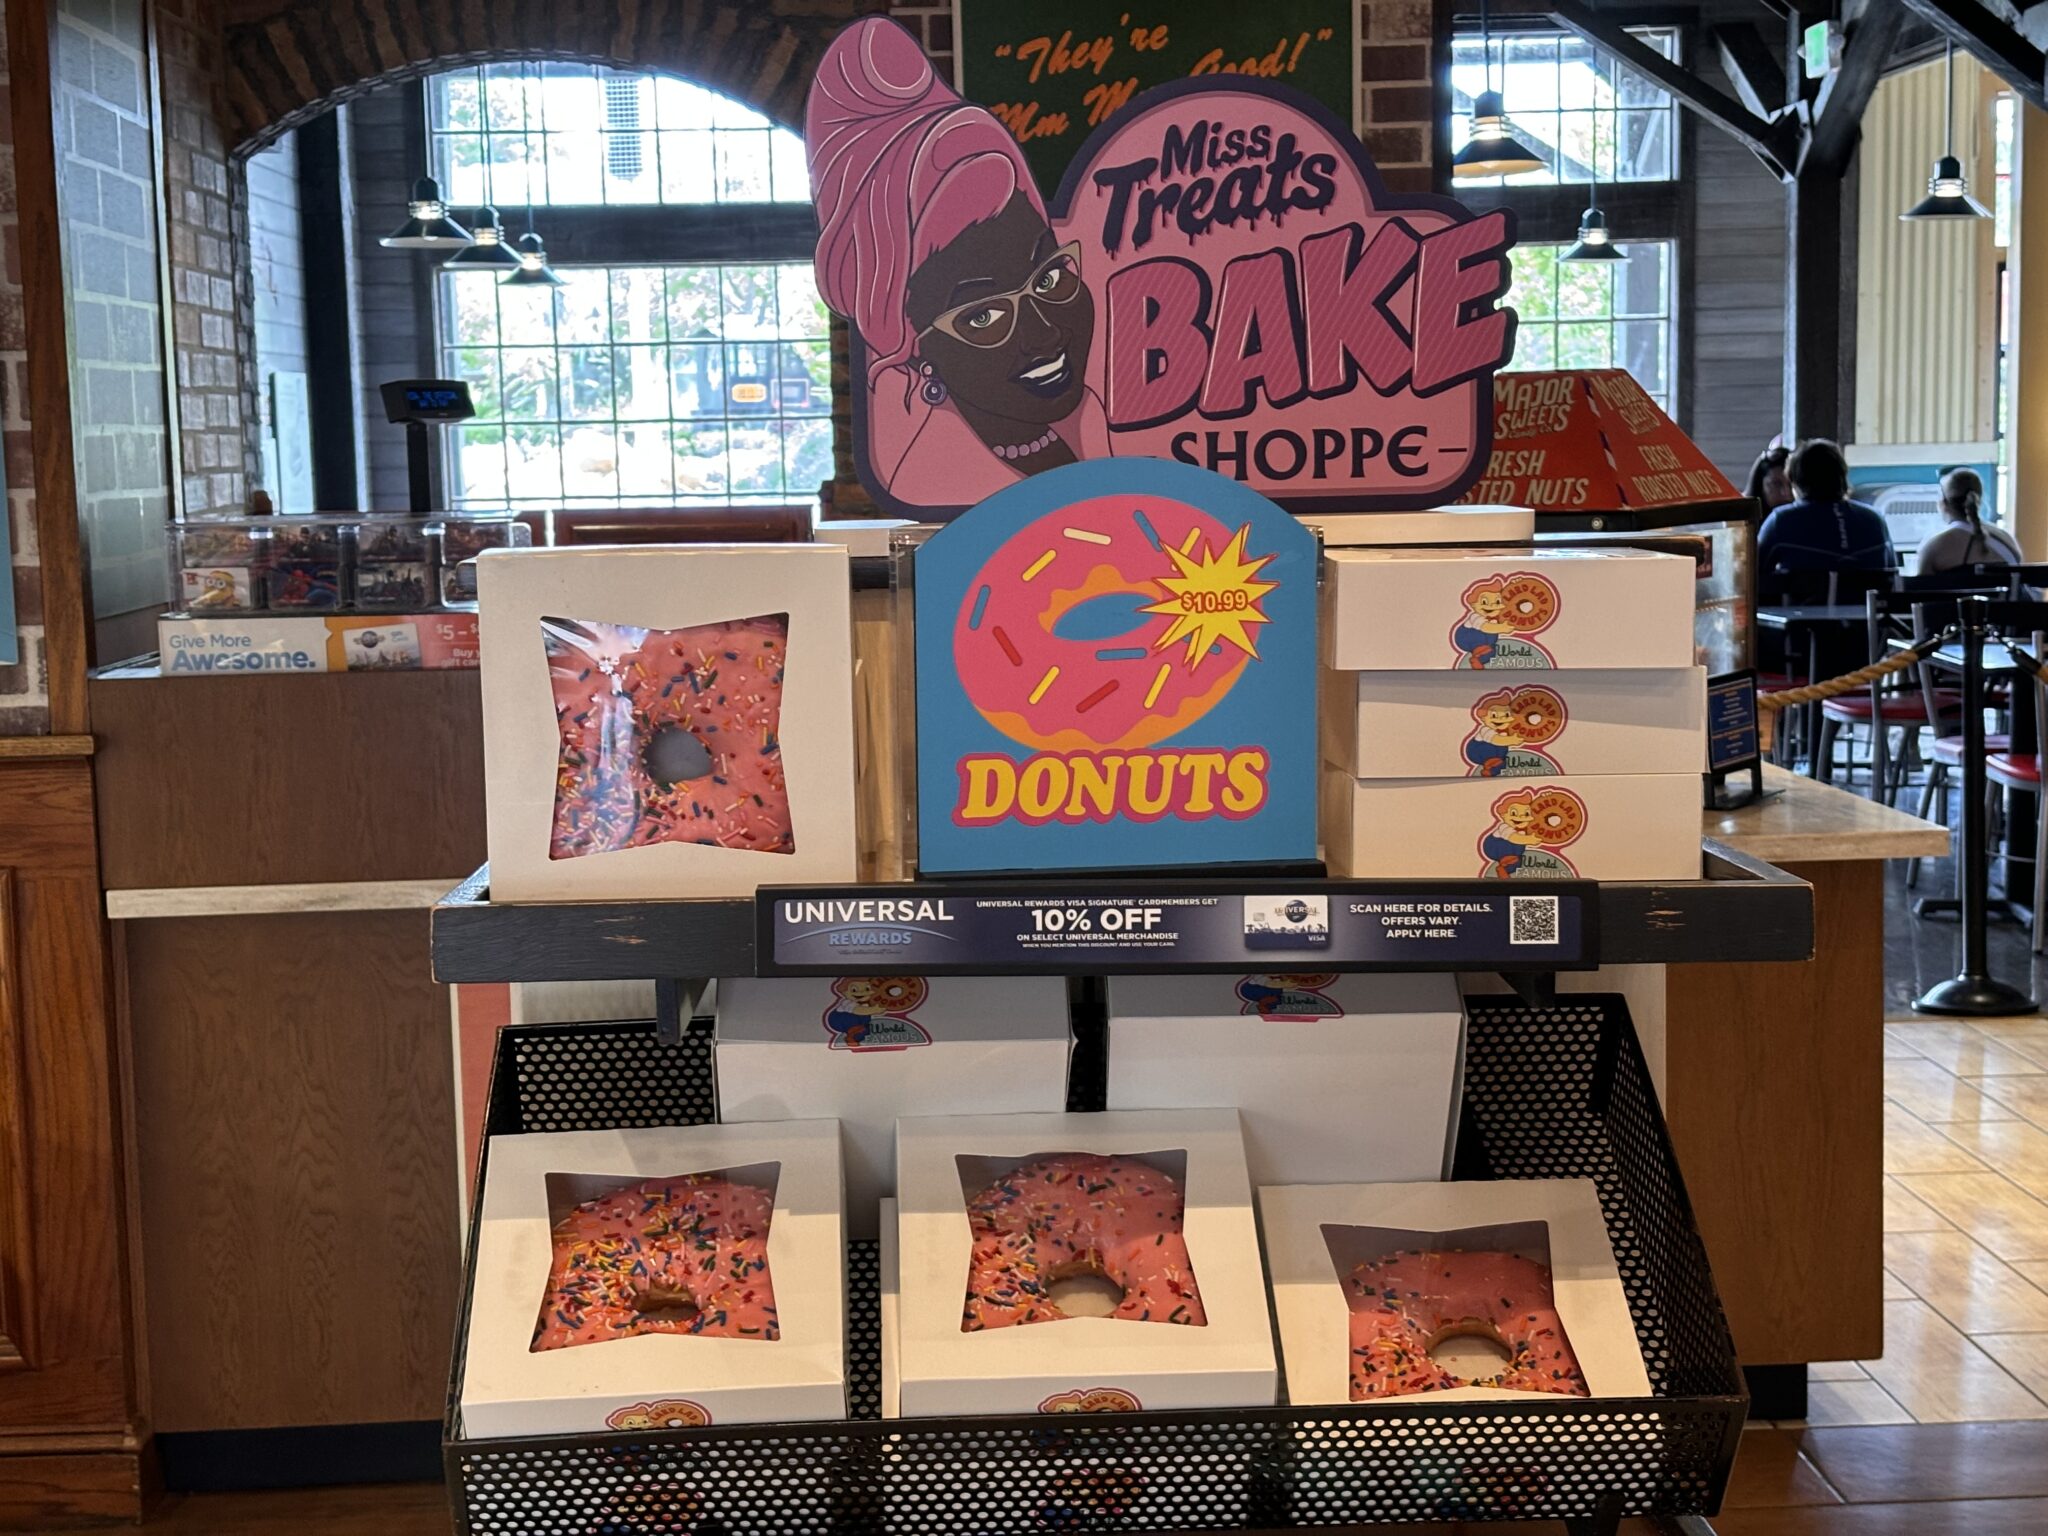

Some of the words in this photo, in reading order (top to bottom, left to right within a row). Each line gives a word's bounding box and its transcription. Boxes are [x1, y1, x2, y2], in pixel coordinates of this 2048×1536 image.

[1160, 119, 1271, 183] Miss
[1092, 133, 1337, 261] Treats
[1105, 209, 1519, 432] BAKE
[1493, 376, 1574, 411] MAJOR
[1494, 404, 1571, 439] SWEETS
[1170, 425, 1429, 481] SHOPPE
[1638, 444, 1682, 471] FRESH
[1486, 450, 1546, 477] RESH
[1524, 477, 1589, 505] NUTS
[1631, 473, 1689, 502] ROASTED
[1682, 469, 1722, 495] NUTS
[1181, 590, 1248, 613] $10.99
[1503, 609, 1549, 626] DONUTS
[169, 635, 206, 649] Give
[210, 634, 252, 648] More
[1496, 644, 1533, 657] World
[171, 650, 316, 671] Awesome.
[1489, 657, 1544, 668] FAMOUS
[1512, 719, 1555, 737] DONUTS
[1505, 756, 1542, 769] World
[955, 748, 1268, 823] DONUTS
[1531, 822, 1575, 839] DONUTS
[1521, 855, 1558, 868] World
[1515, 868, 1569, 879] FAMOUS
[785, 899, 954, 923] UNIVERSAL
[976, 900, 1023, 908] UNIVERSAL
[1138, 898, 1200, 906] CARDMEMBERS
[1350, 904, 1381, 913] SCAN
[1384, 904, 1415, 912] HERE
[1417, 903, 1441, 912] FOR
[1443, 903, 1493, 912] DETAILS.
[1031, 909, 1091, 931] 10%
[1100, 908, 1162, 931] OFF
[1381, 916, 1426, 925] OFFERS
[1428, 916, 1462, 925] VARY.
[829, 931, 913, 946] REWARDS
[1032, 933, 1063, 941] SELECT
[1386, 929, 1421, 938] APPLY
[1424, 929, 1457, 938] HERE.
